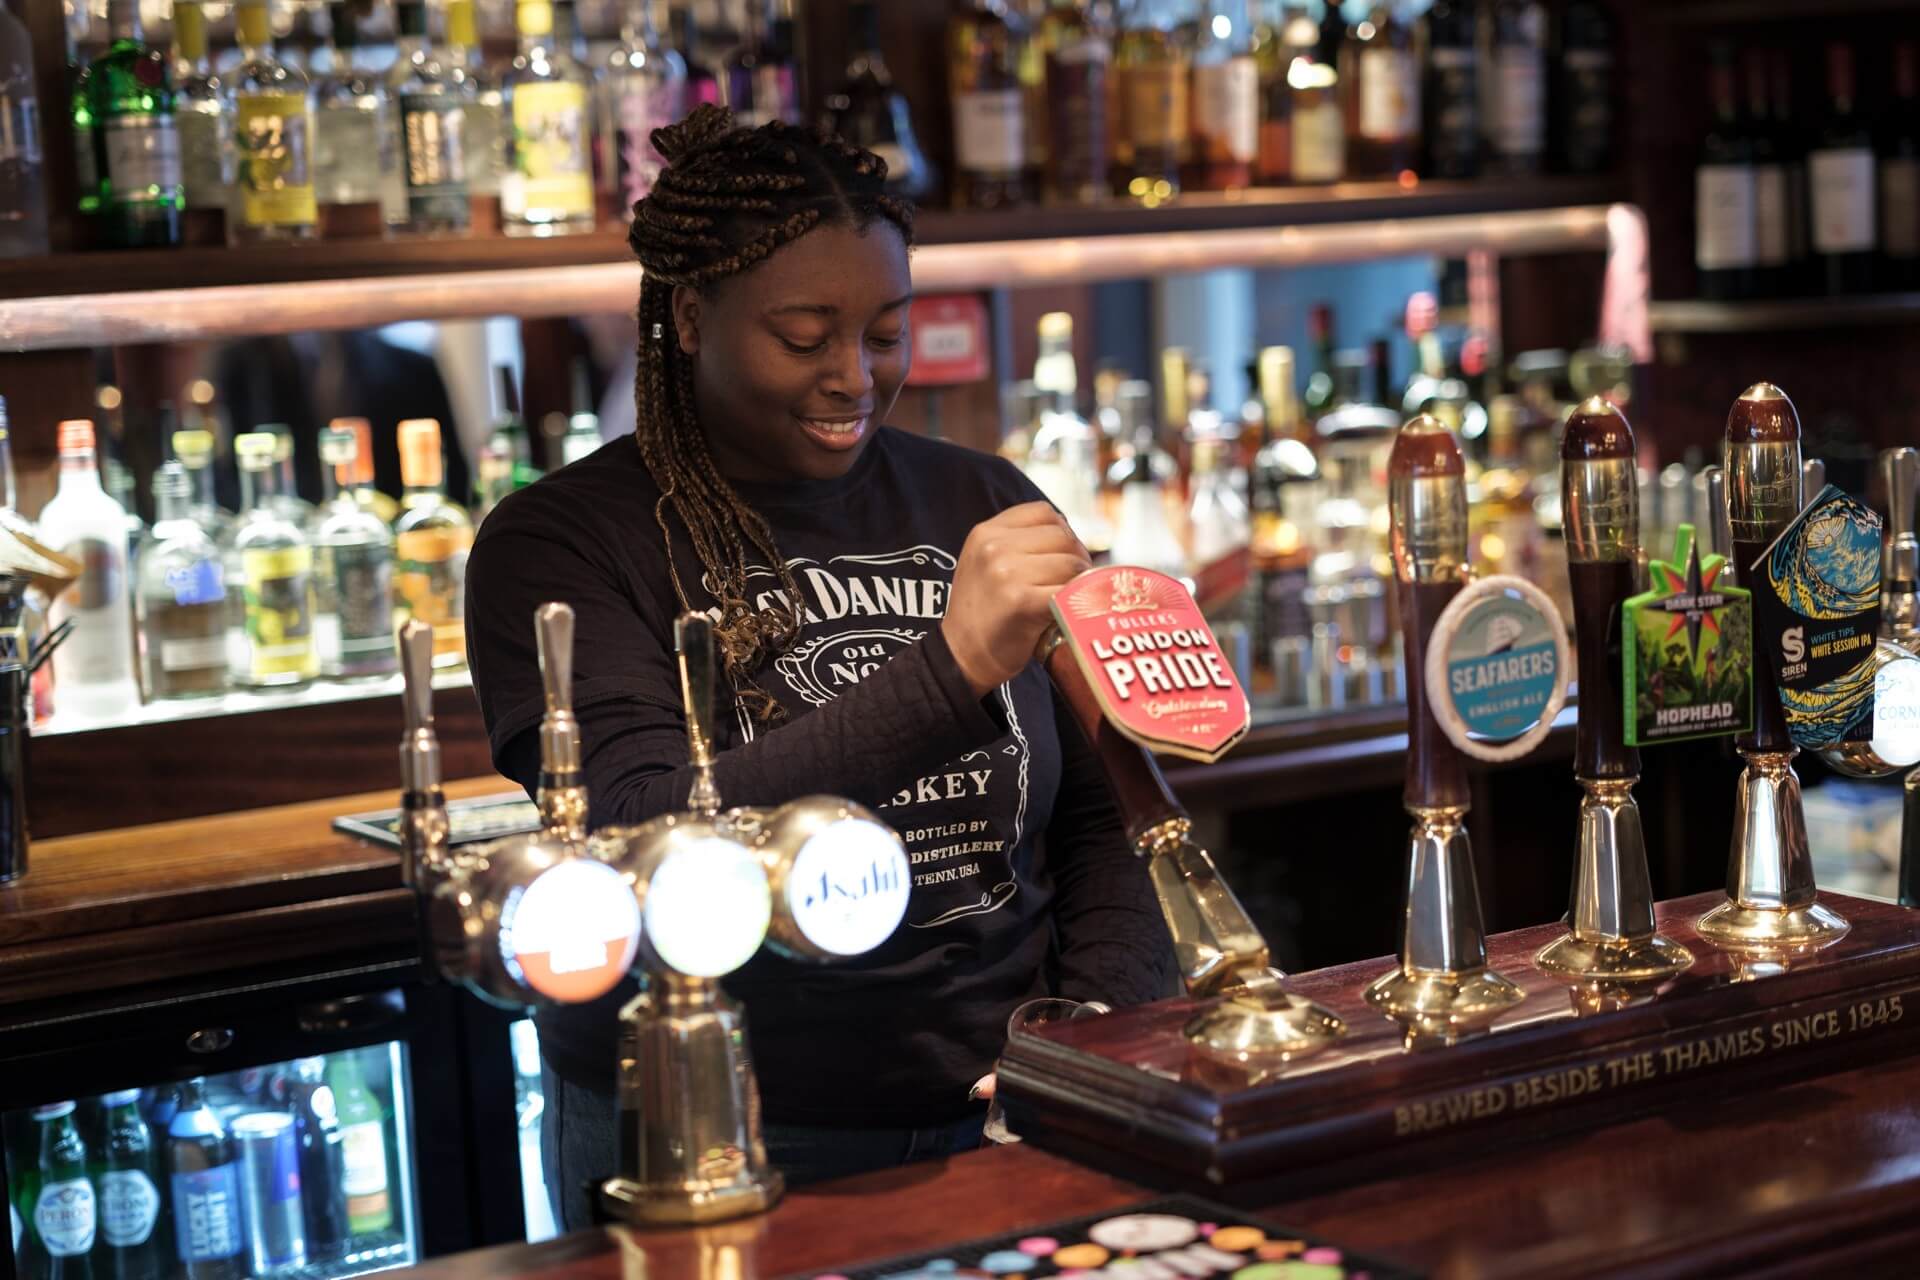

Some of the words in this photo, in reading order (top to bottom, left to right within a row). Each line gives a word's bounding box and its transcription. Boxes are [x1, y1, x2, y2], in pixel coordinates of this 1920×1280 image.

[804, 568, 952, 620] DANIE
[1697, 595, 1723, 608] STAR
[1092, 629, 1210, 660] LONDON
[1811, 631, 1836, 644] WHITE
[1839, 626, 1855, 637] TIPS
[1811, 643, 1832, 658] WHITE
[1833, 636, 1860, 653] SESSION
[1861, 633, 1872, 647] IPA
[842, 643, 886, 659] Old
[1104, 652, 1232, 699] PRIDE
[1453, 650, 1554, 694] SEAFARERS
[1782, 662, 1807, 677] SIREN
[1656, 702, 1733, 725] HOPHEAD
[1878, 705, 1920, 721] CORN
[905, 823, 967, 843] BOTTLED
[970, 820, 988, 832] BY
[911, 840, 1005, 864] DISTILLERY
[1394, 1087, 1507, 1136] BREWED
[1512, 1064, 1602, 1109] BESIDE
[1604, 1052, 1656, 1087] THE
[1662, 1026, 1765, 1074] THAMES
[1771, 1010, 1841, 1049] SINCE
[1848, 996, 1904, 1032] 1845
